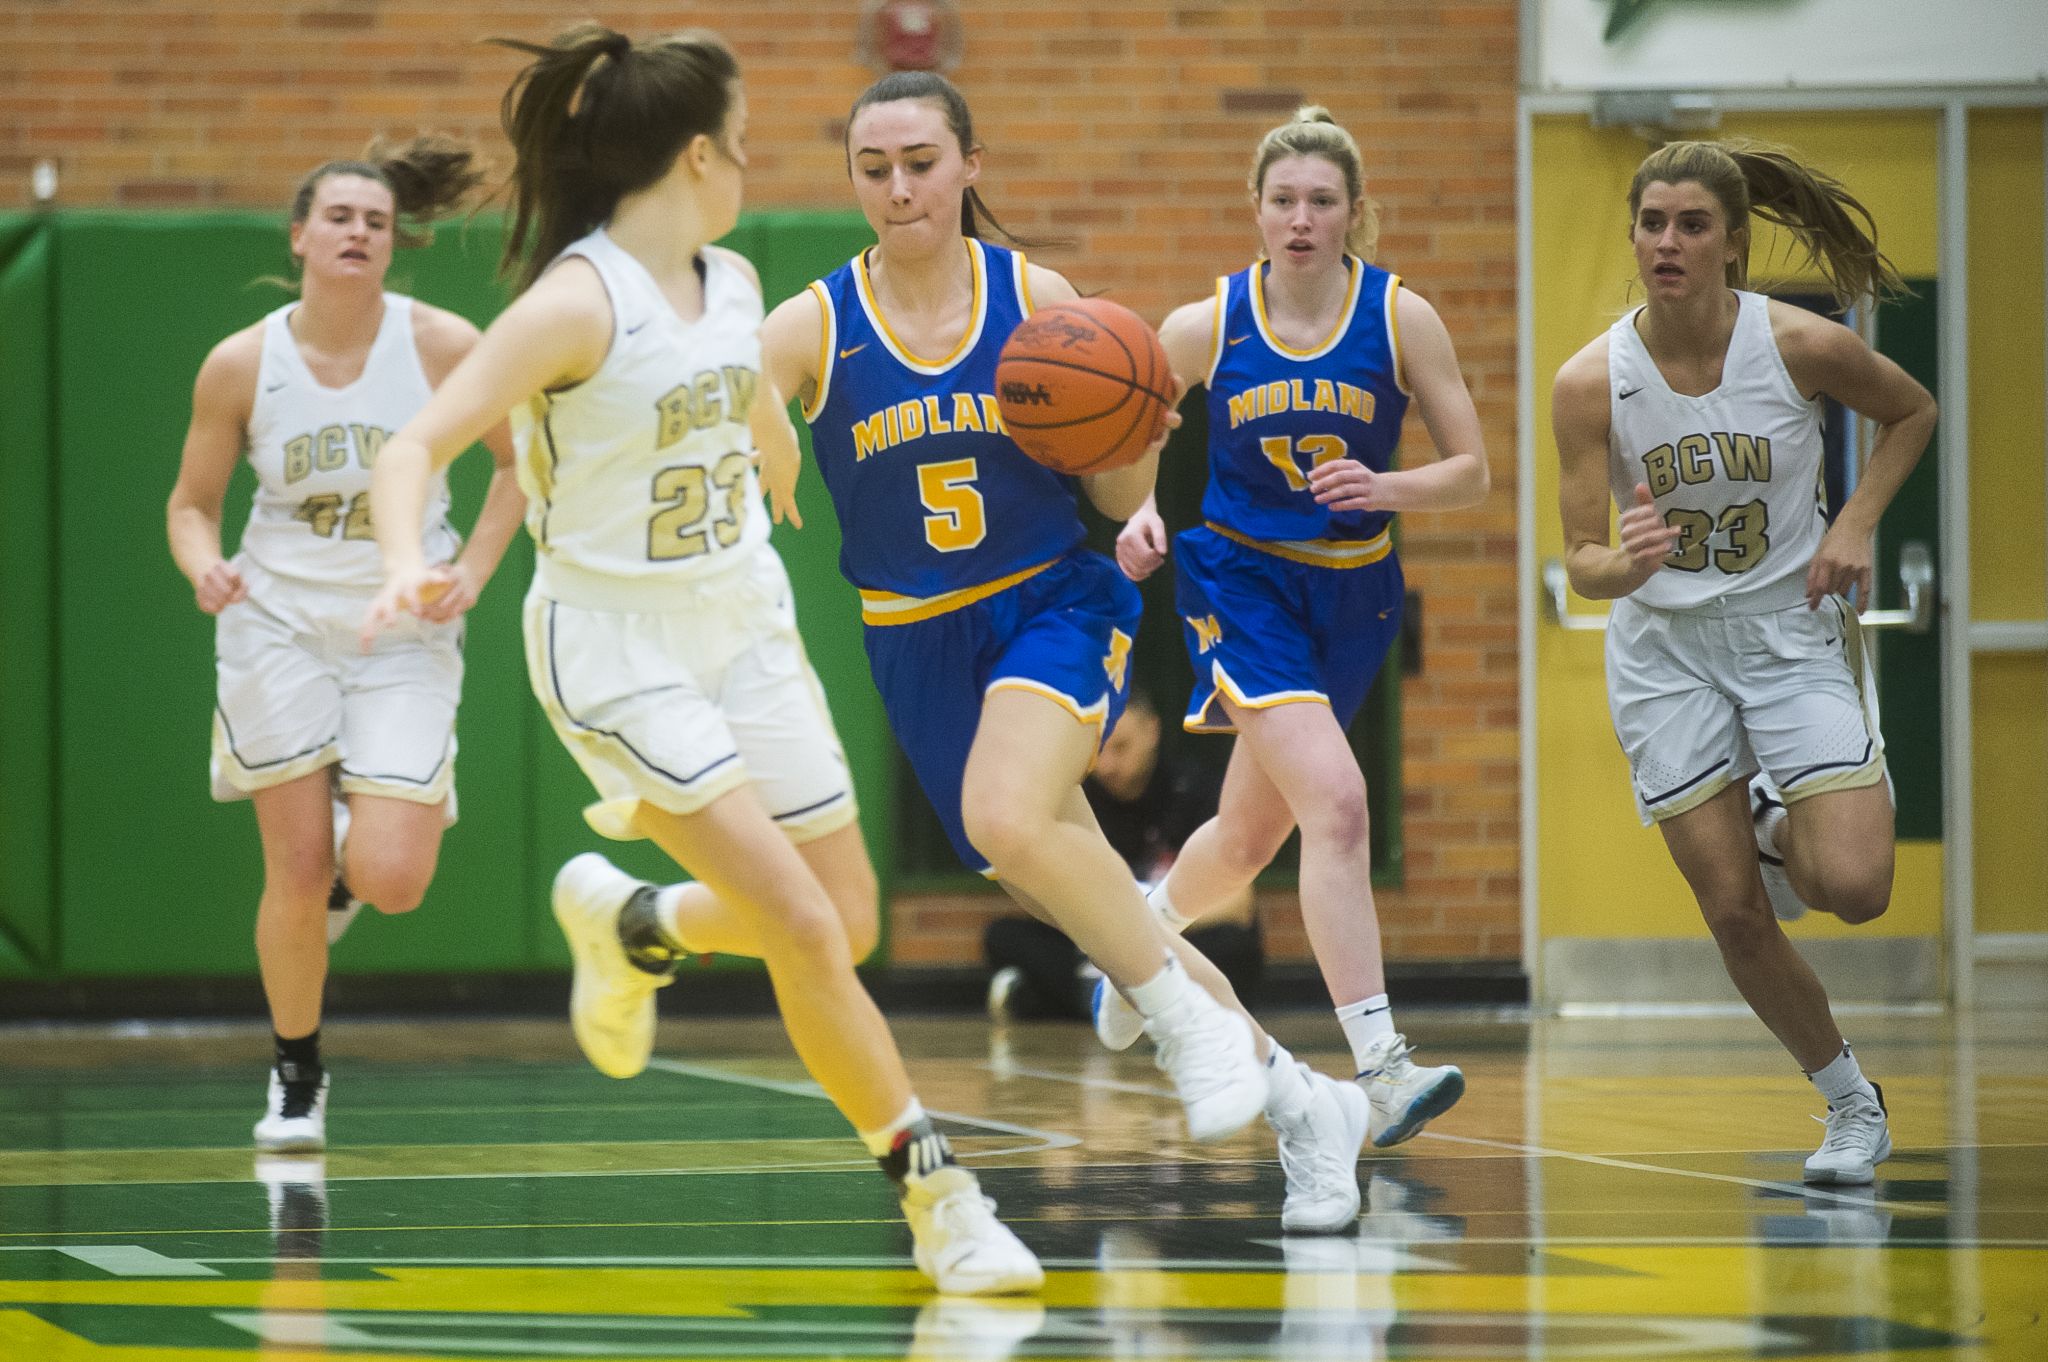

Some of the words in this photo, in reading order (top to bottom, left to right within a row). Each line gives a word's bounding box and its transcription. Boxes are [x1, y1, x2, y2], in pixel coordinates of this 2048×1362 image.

[852, 392, 1010, 462] MIDLAN
[1227, 378, 1376, 430] MIDLAND
[1641, 431, 1772, 499] BCW
[646, 451, 750, 562] 23
[916, 457, 987, 553] 5
[1662, 498, 1770, 575] 33
